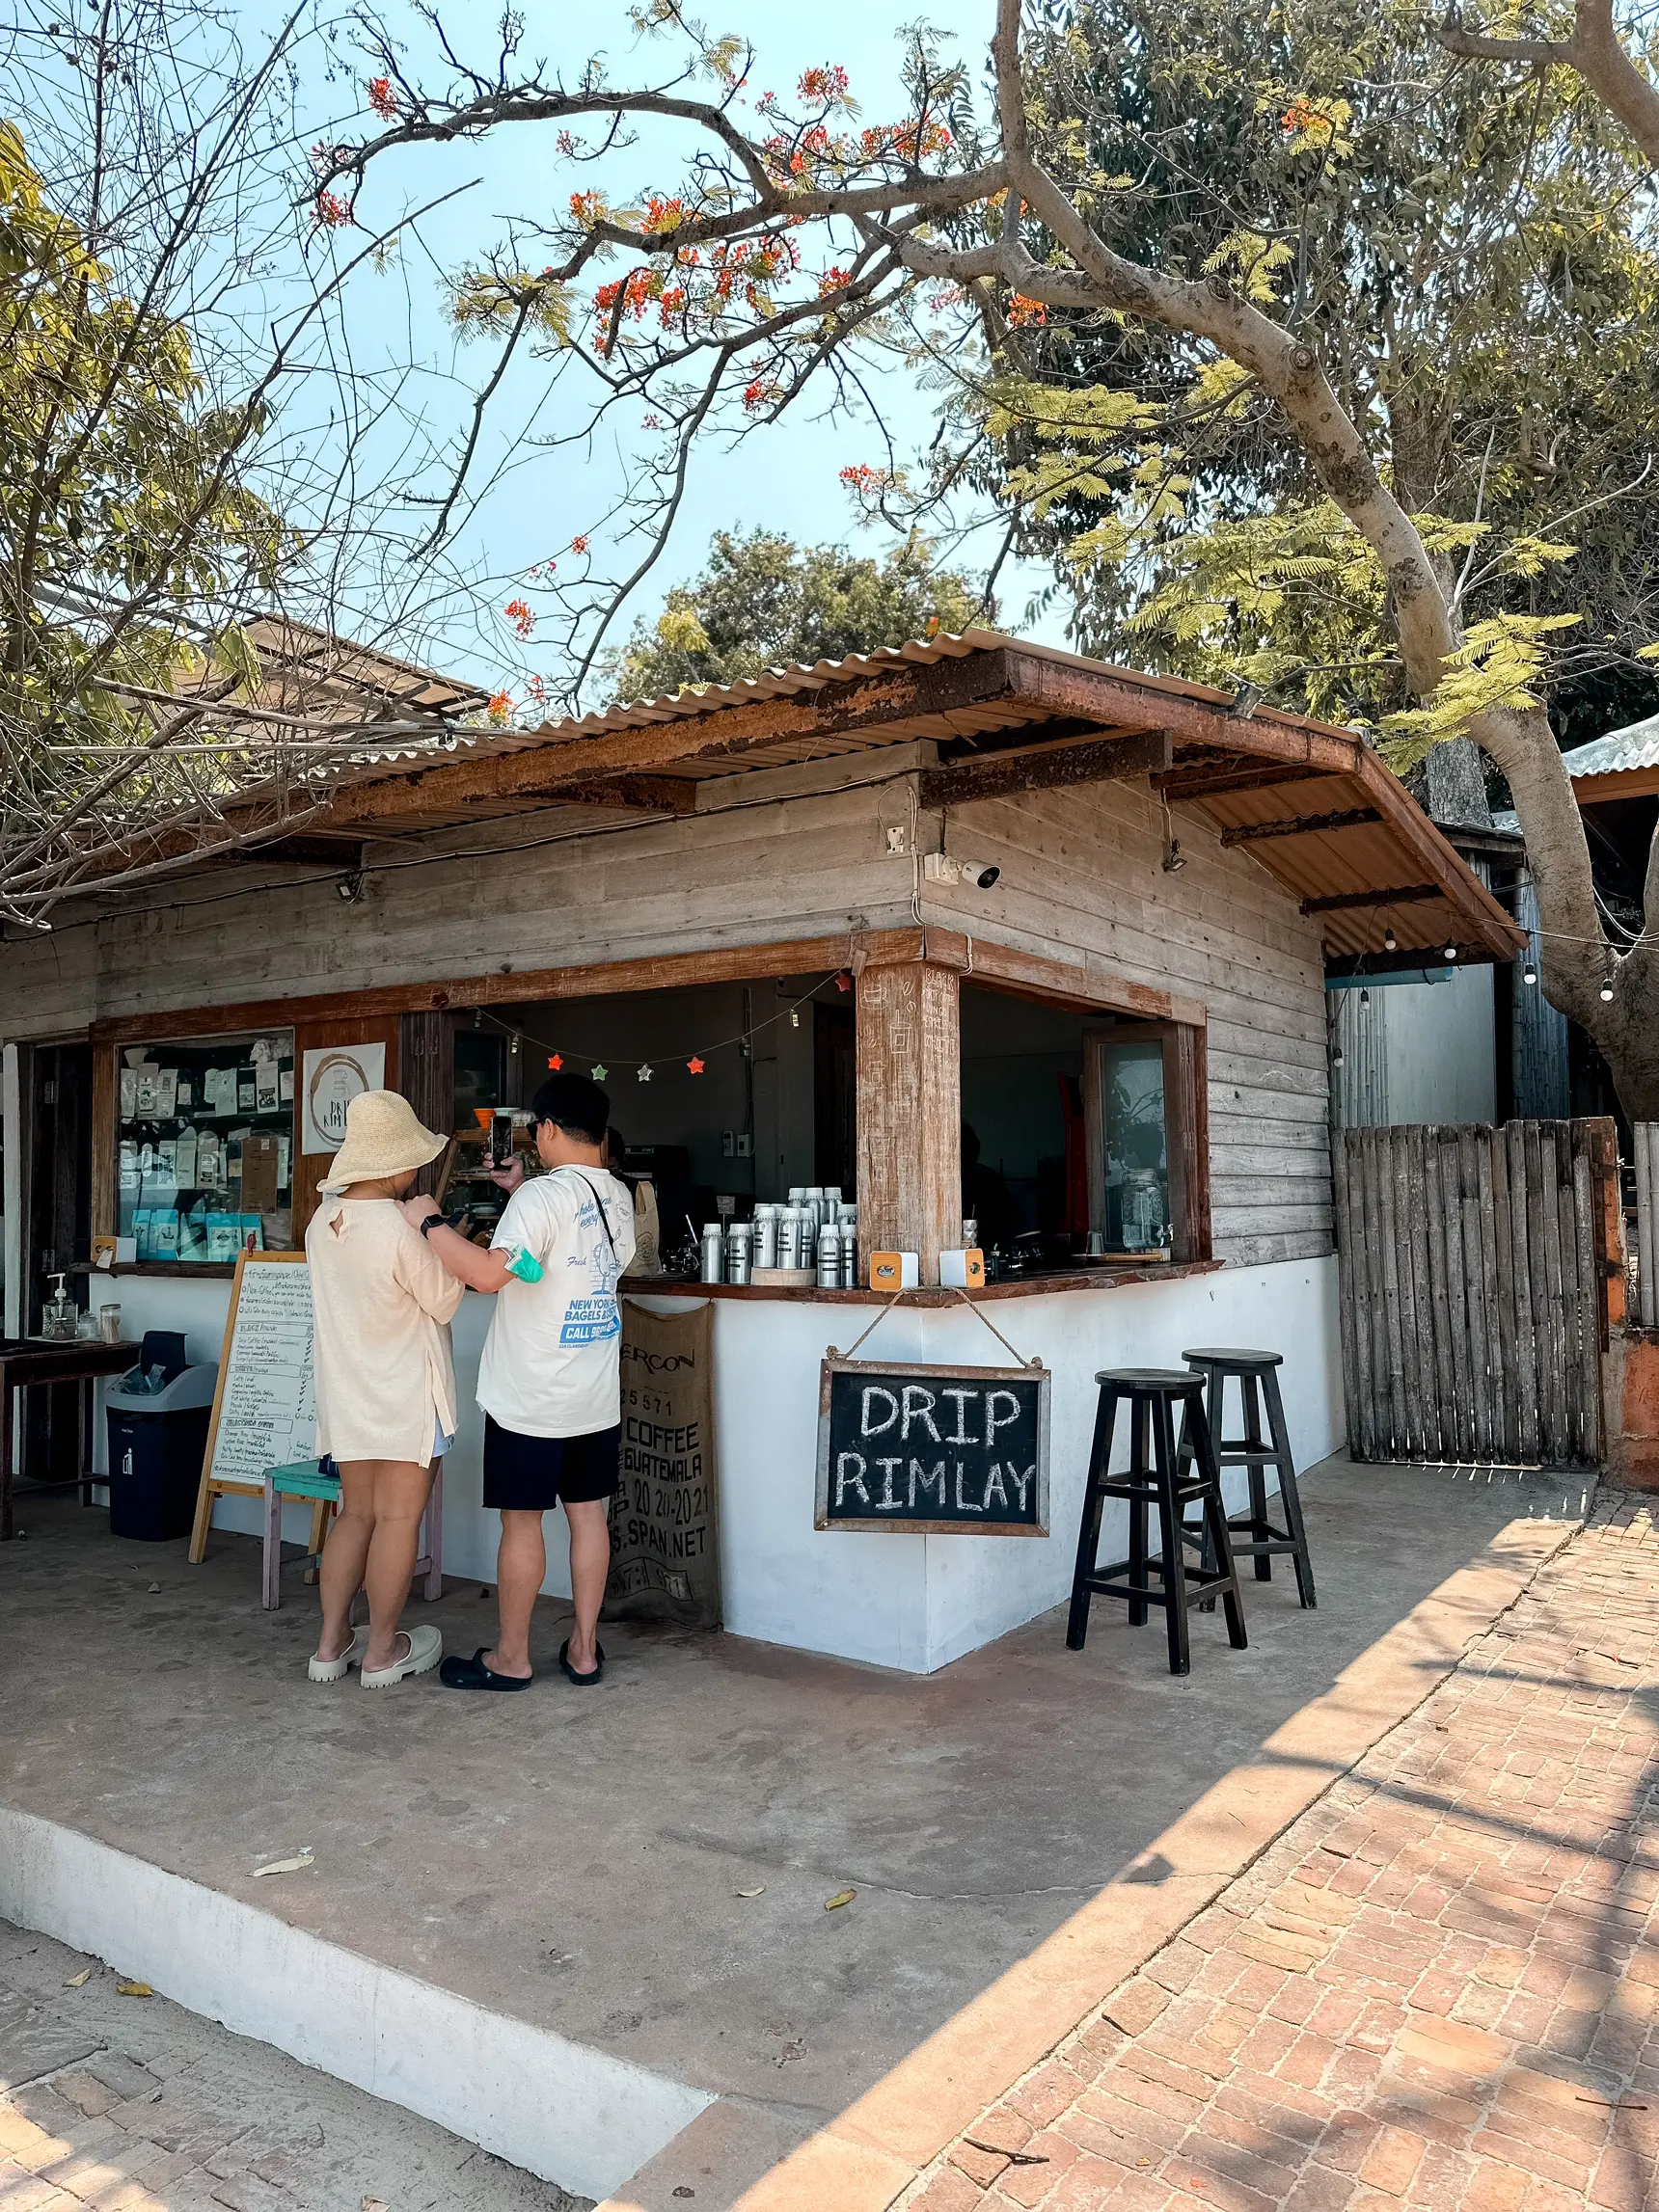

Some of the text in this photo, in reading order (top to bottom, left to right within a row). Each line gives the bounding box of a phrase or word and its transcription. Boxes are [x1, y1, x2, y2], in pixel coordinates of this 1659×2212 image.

[324, 1113, 348, 1128] RIML
[567, 1256, 587, 1267] Fresh
[569, 1300, 592, 1309] NEW
[564, 1310, 600, 1321] BAGELS
[565, 1327, 590, 1338] CALL
[861, 1385, 1021, 1447] DRIP
[627, 1416, 700, 1454] COFFEE
[624, 1446, 702, 1484] GUATEMALA
[834, 1451, 1037, 1512] RIMLAY
